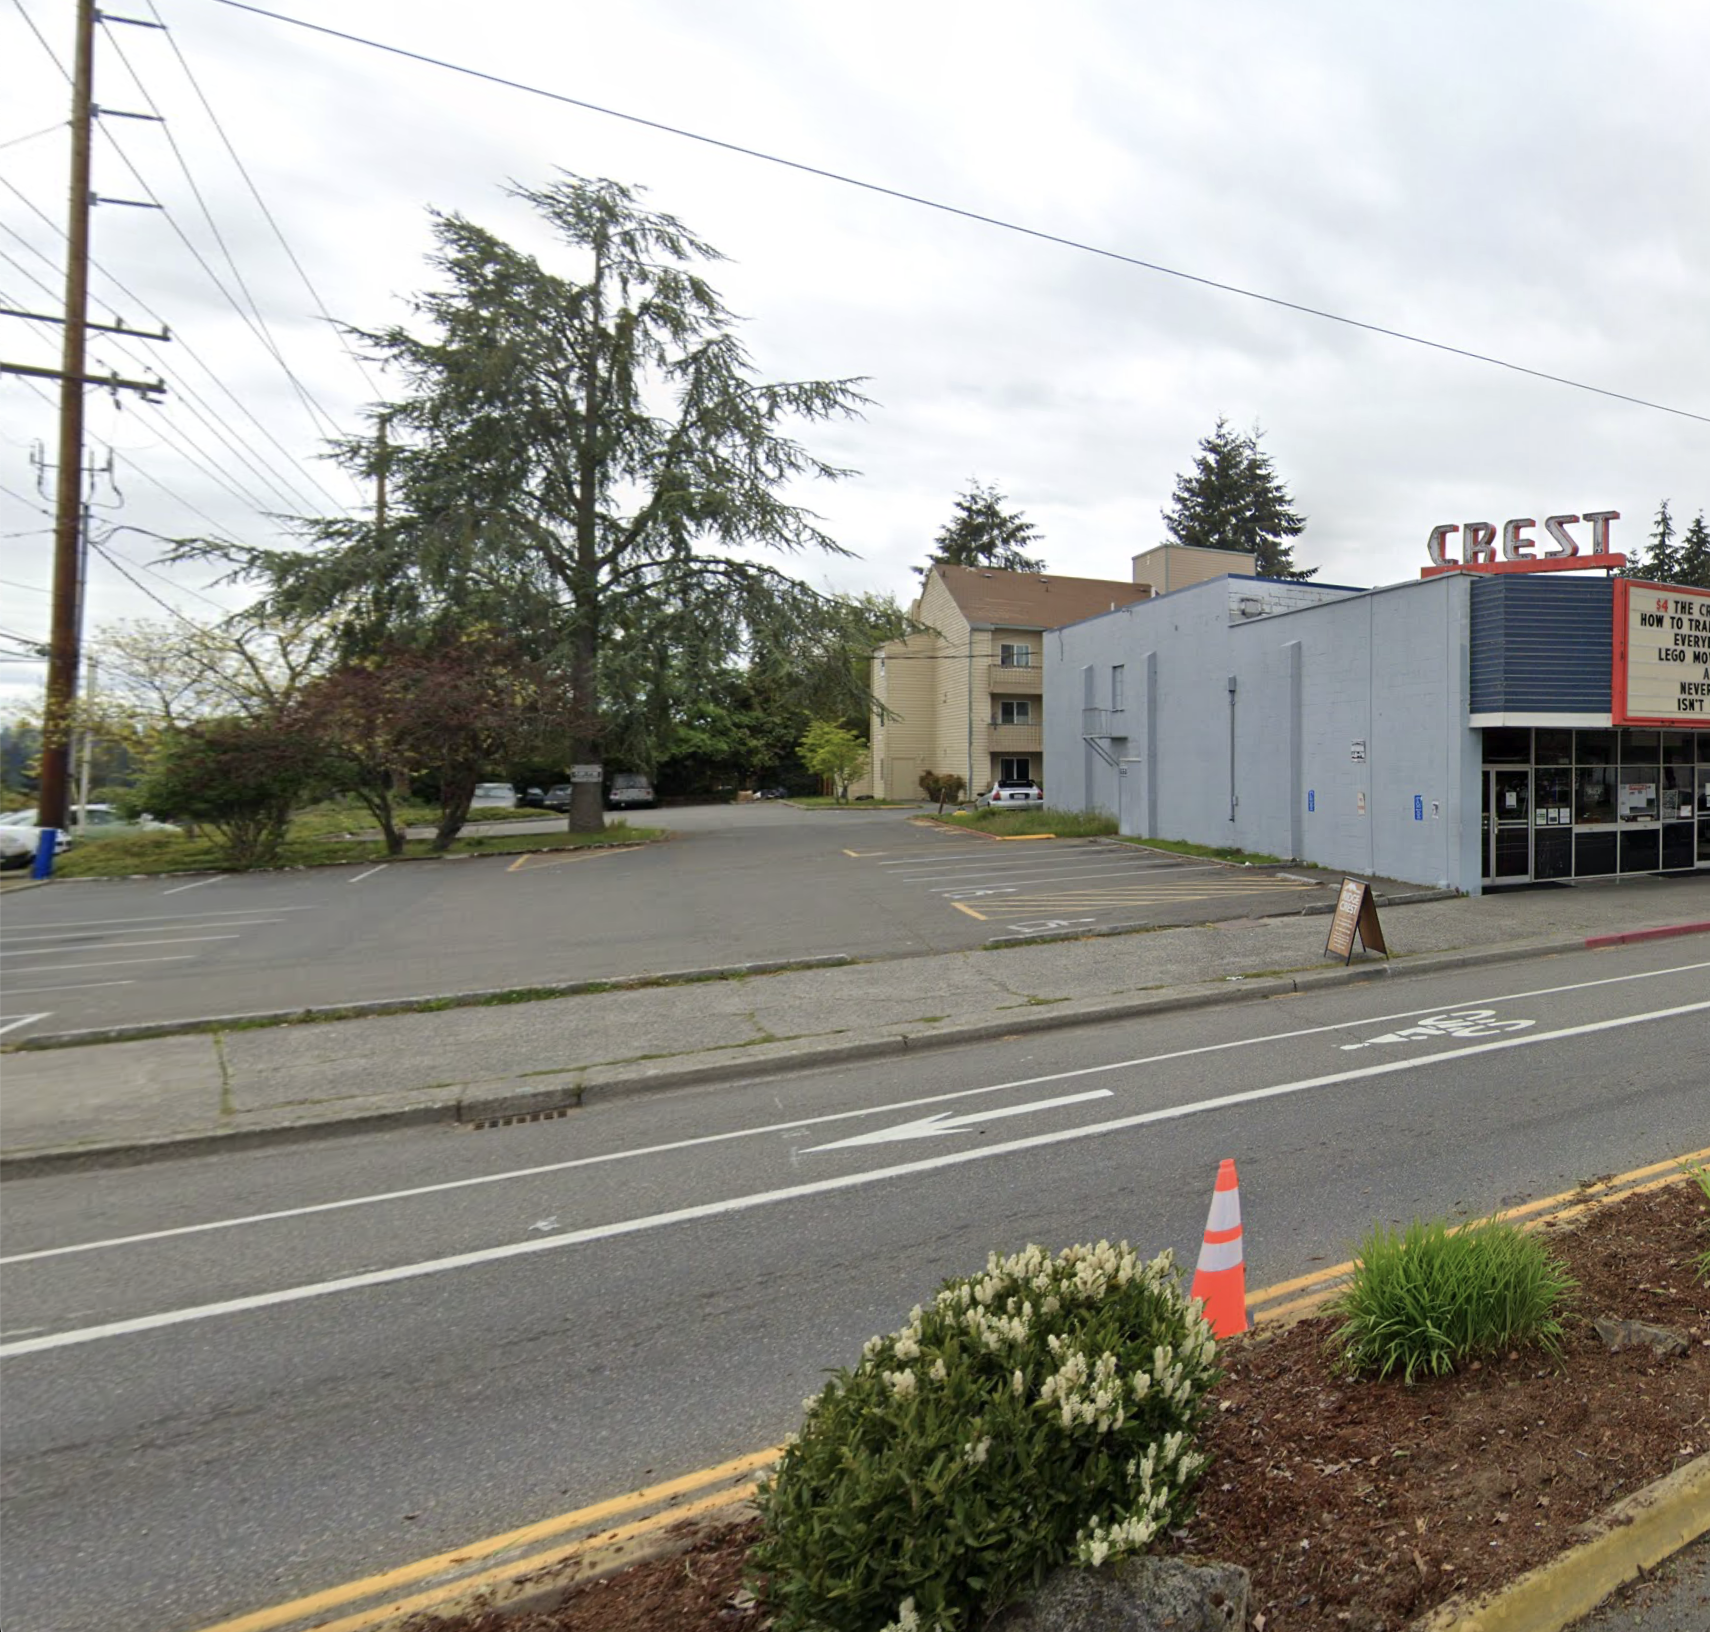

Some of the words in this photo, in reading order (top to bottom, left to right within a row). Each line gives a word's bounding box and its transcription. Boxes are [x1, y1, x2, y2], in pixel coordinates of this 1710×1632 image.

[1427, 510, 1620, 566] CREST
[1656, 598, 1669, 613] $4
[1674, 600, 1694, 615] THE
[1640, 613, 1664, 628] HOW
[1670, 616, 1683, 630] TO
[1658, 647, 1686, 662] LEGO
[1677, 698, 1704, 712] ISN'T
